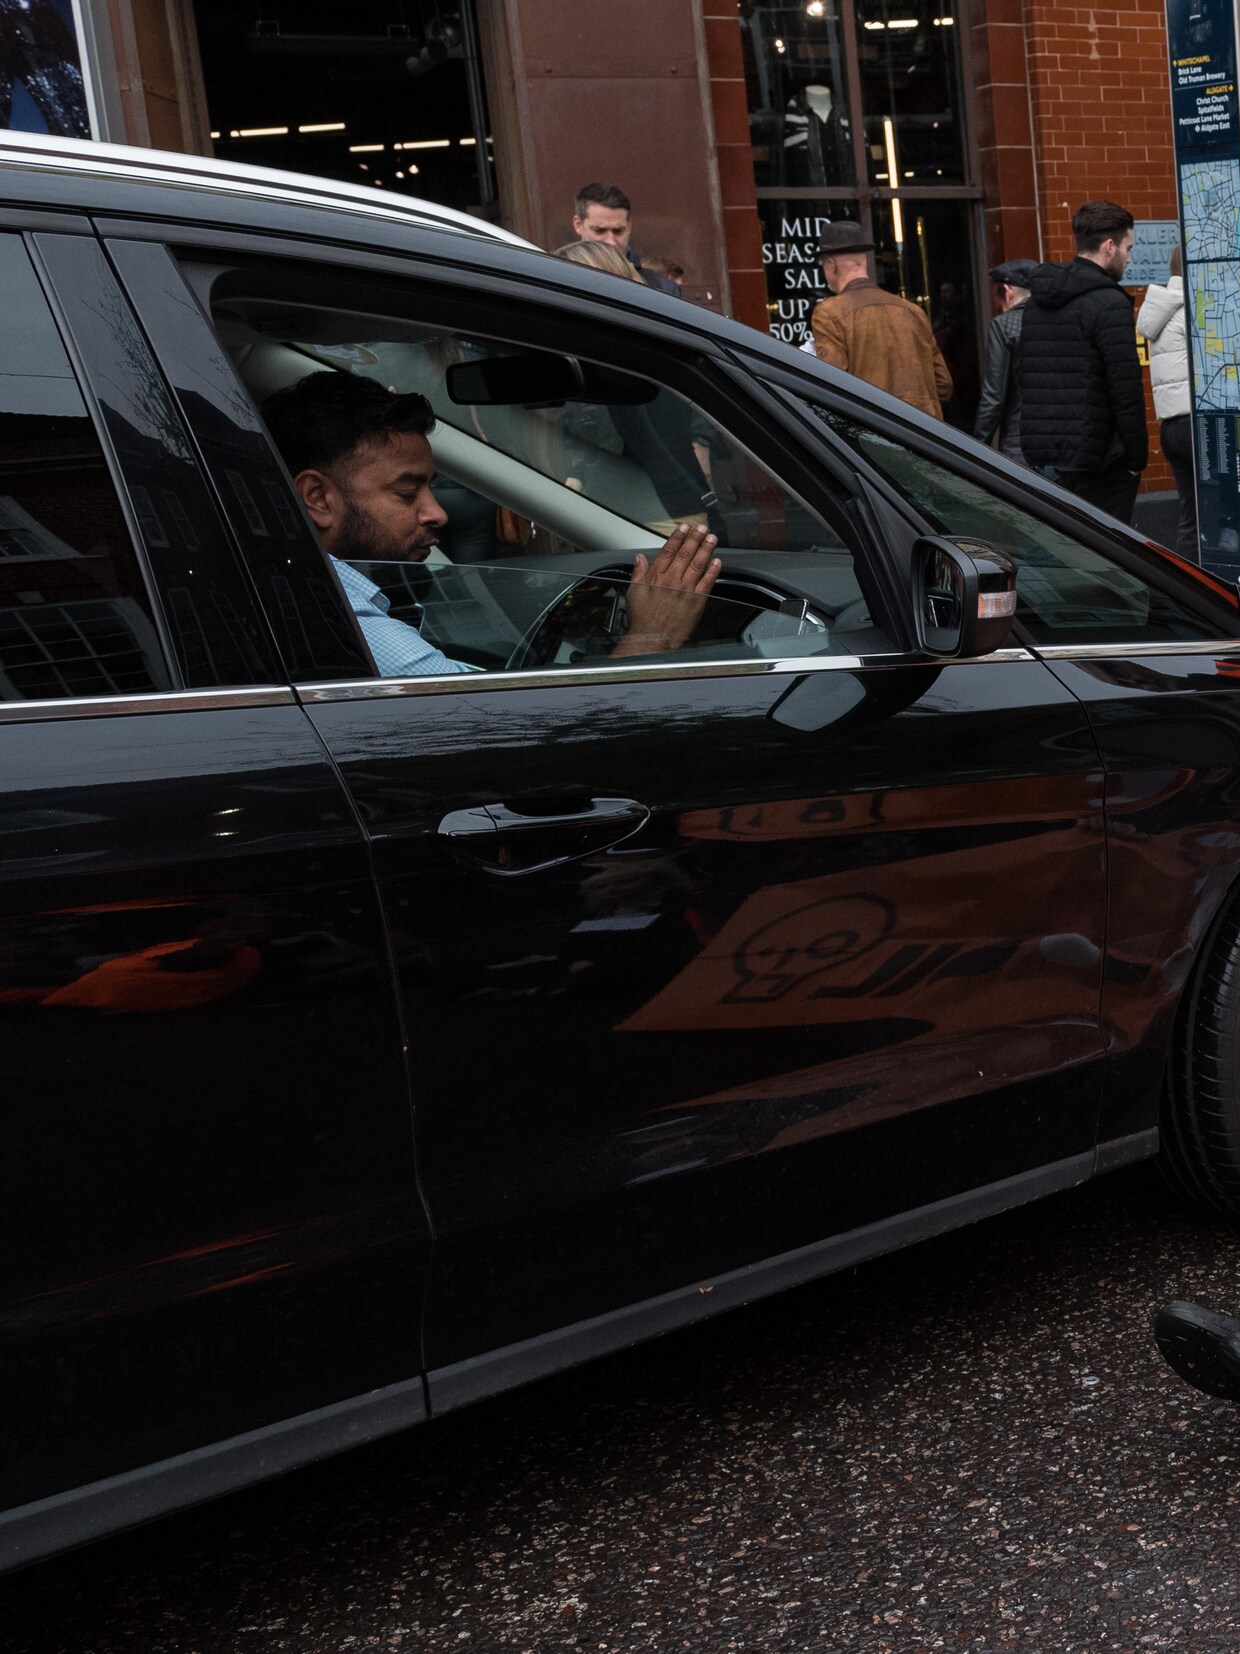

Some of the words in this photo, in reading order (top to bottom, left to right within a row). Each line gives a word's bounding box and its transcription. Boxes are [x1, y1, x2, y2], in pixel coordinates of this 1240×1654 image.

[1178, 55, 1211, 66] WHITECHAPEL
[1178, 67, 1190, 76] Brick
[1190, 66, 1202, 74] Lane
[1178, 77, 1188, 85] Old
[1188, 75, 1205, 83] Truman
[1205, 72, 1226, 80] Brewery
[1205, 85, 1228, 95] ALDGATE
[1196, 97, 1211, 105] Christ
[1211, 94, 1229, 103] Church
[1201, 115, 1212, 123] Lane
[1212, 113, 1230, 121] Market
[1201, 124, 1219, 132] Aldgate
[1219, 122, 1231, 130] East
[762, 243, 822, 264] SEAS
[784, 269, 827, 289] SAL
[778, 299, 809, 319] UP
[769, 322, 813, 342] 50%
